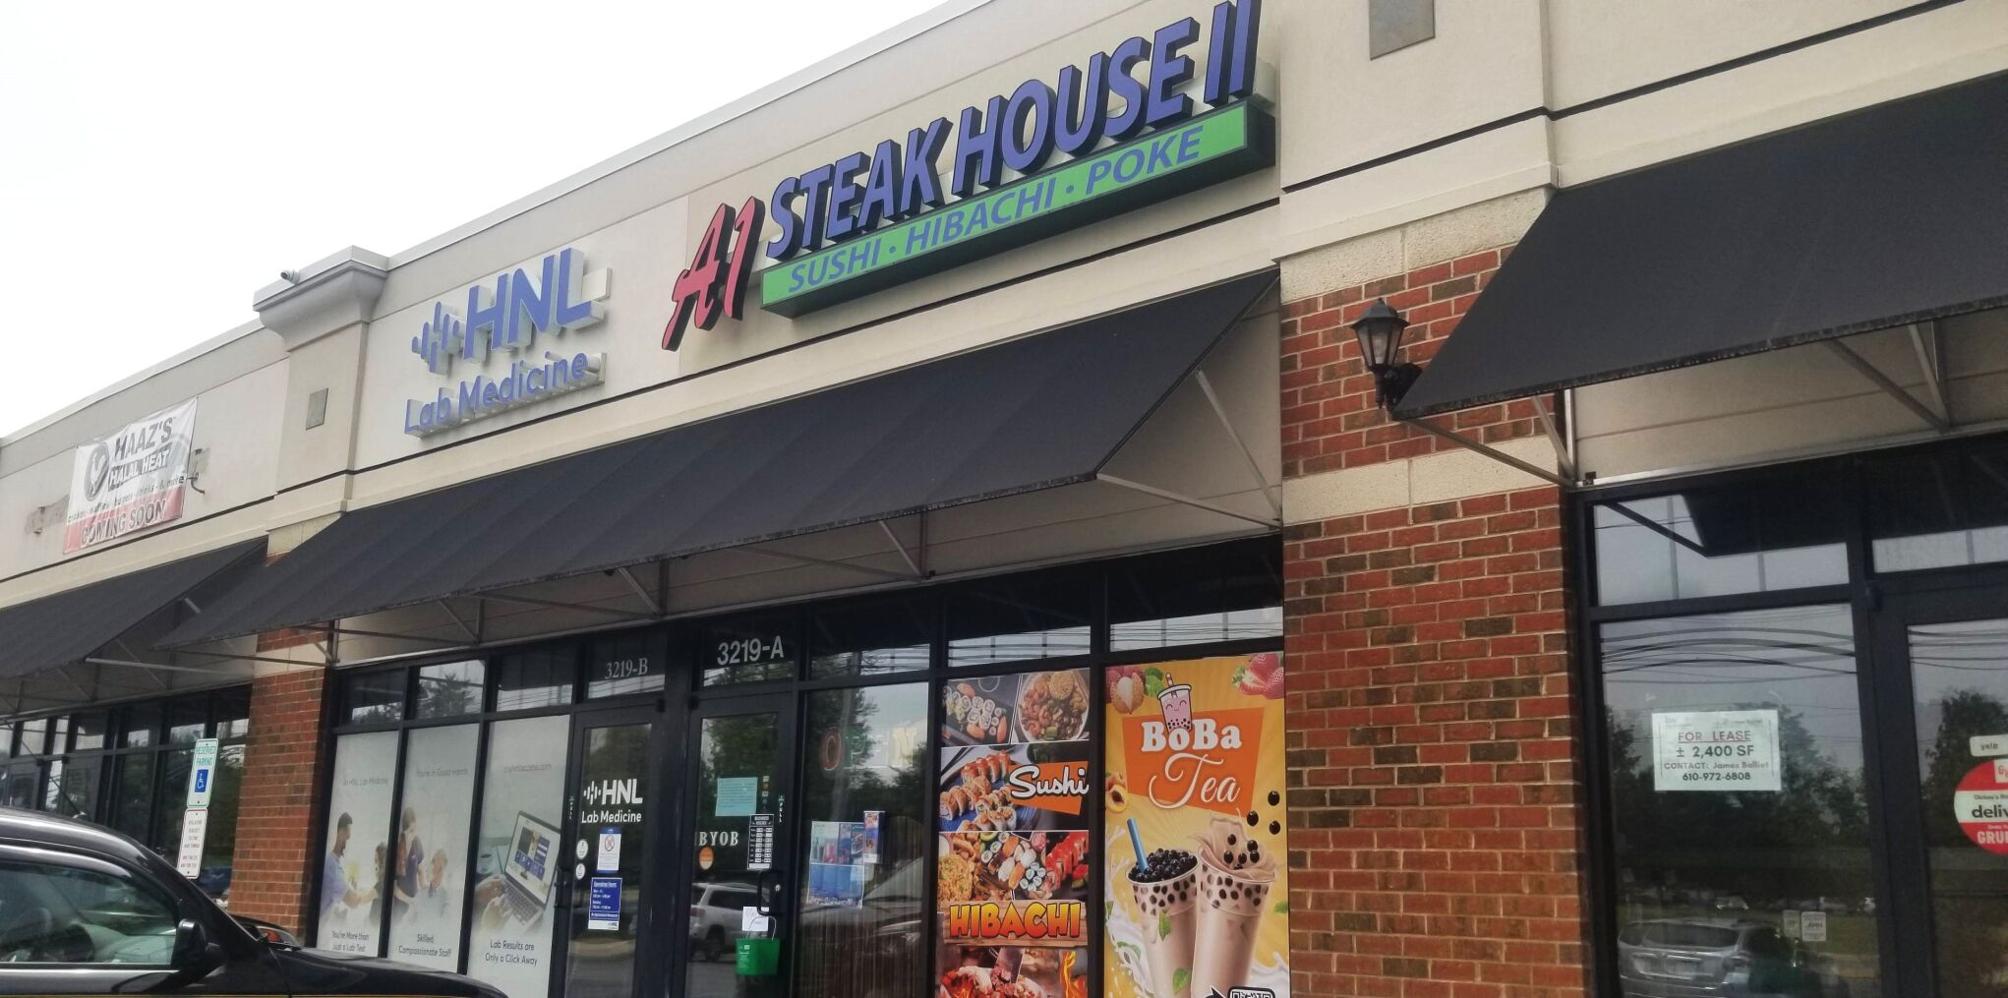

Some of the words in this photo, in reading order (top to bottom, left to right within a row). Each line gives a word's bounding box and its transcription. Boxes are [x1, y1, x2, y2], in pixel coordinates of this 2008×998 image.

[662, 196, 764, 351] A1
[766, 117, 951, 261] STEAK
[951, 16, 1200, 198] HOUSE
[1204, 0, 1261, 106] II
[788, 239, 881, 294] SUSHI
[905, 178, 1056, 256] HIBACHI
[1085, 126, 1204, 196] POKE
[463, 248, 598, 361] HNL
[404, 387, 452, 434] Lab
[459, 351, 590, 421] Medicine
[81, 513, 127, 544] COMING
[129, 499, 166, 529] SOON
[717, 636, 784, 665] 3219-A
[605, 658, 648, 679] 3219-B
[1141, 718, 1242, 752] BoBa
[1678, 732, 1702, 741] FOR
[1713, 730, 1751, 741] LEASE
[1981, 743, 1998, 752] yelp
[1692, 745, 1733, 759] 2,400
[1737, 744, 1754, 756] SF
[1008, 765, 1090, 799] Sushi
[1149, 752, 1241, 809] Tea
[1682, 772, 1751, 781] 610-972-6808
[602, 778, 643, 805] HNL
[581, 810, 599, 823] Lab
[600, 809, 642, 823] Medicine
[699, 831, 739, 847] BYOB
[949, 901, 1082, 939] HIBACHI
[490, 939, 501, 949] Lab
[503, 940, 523, 951] Results
[525, 943, 535, 951] are
[485, 952, 498, 963] Only
[505, 953, 520, 964] Click
[522, 955, 538, 967] Away
